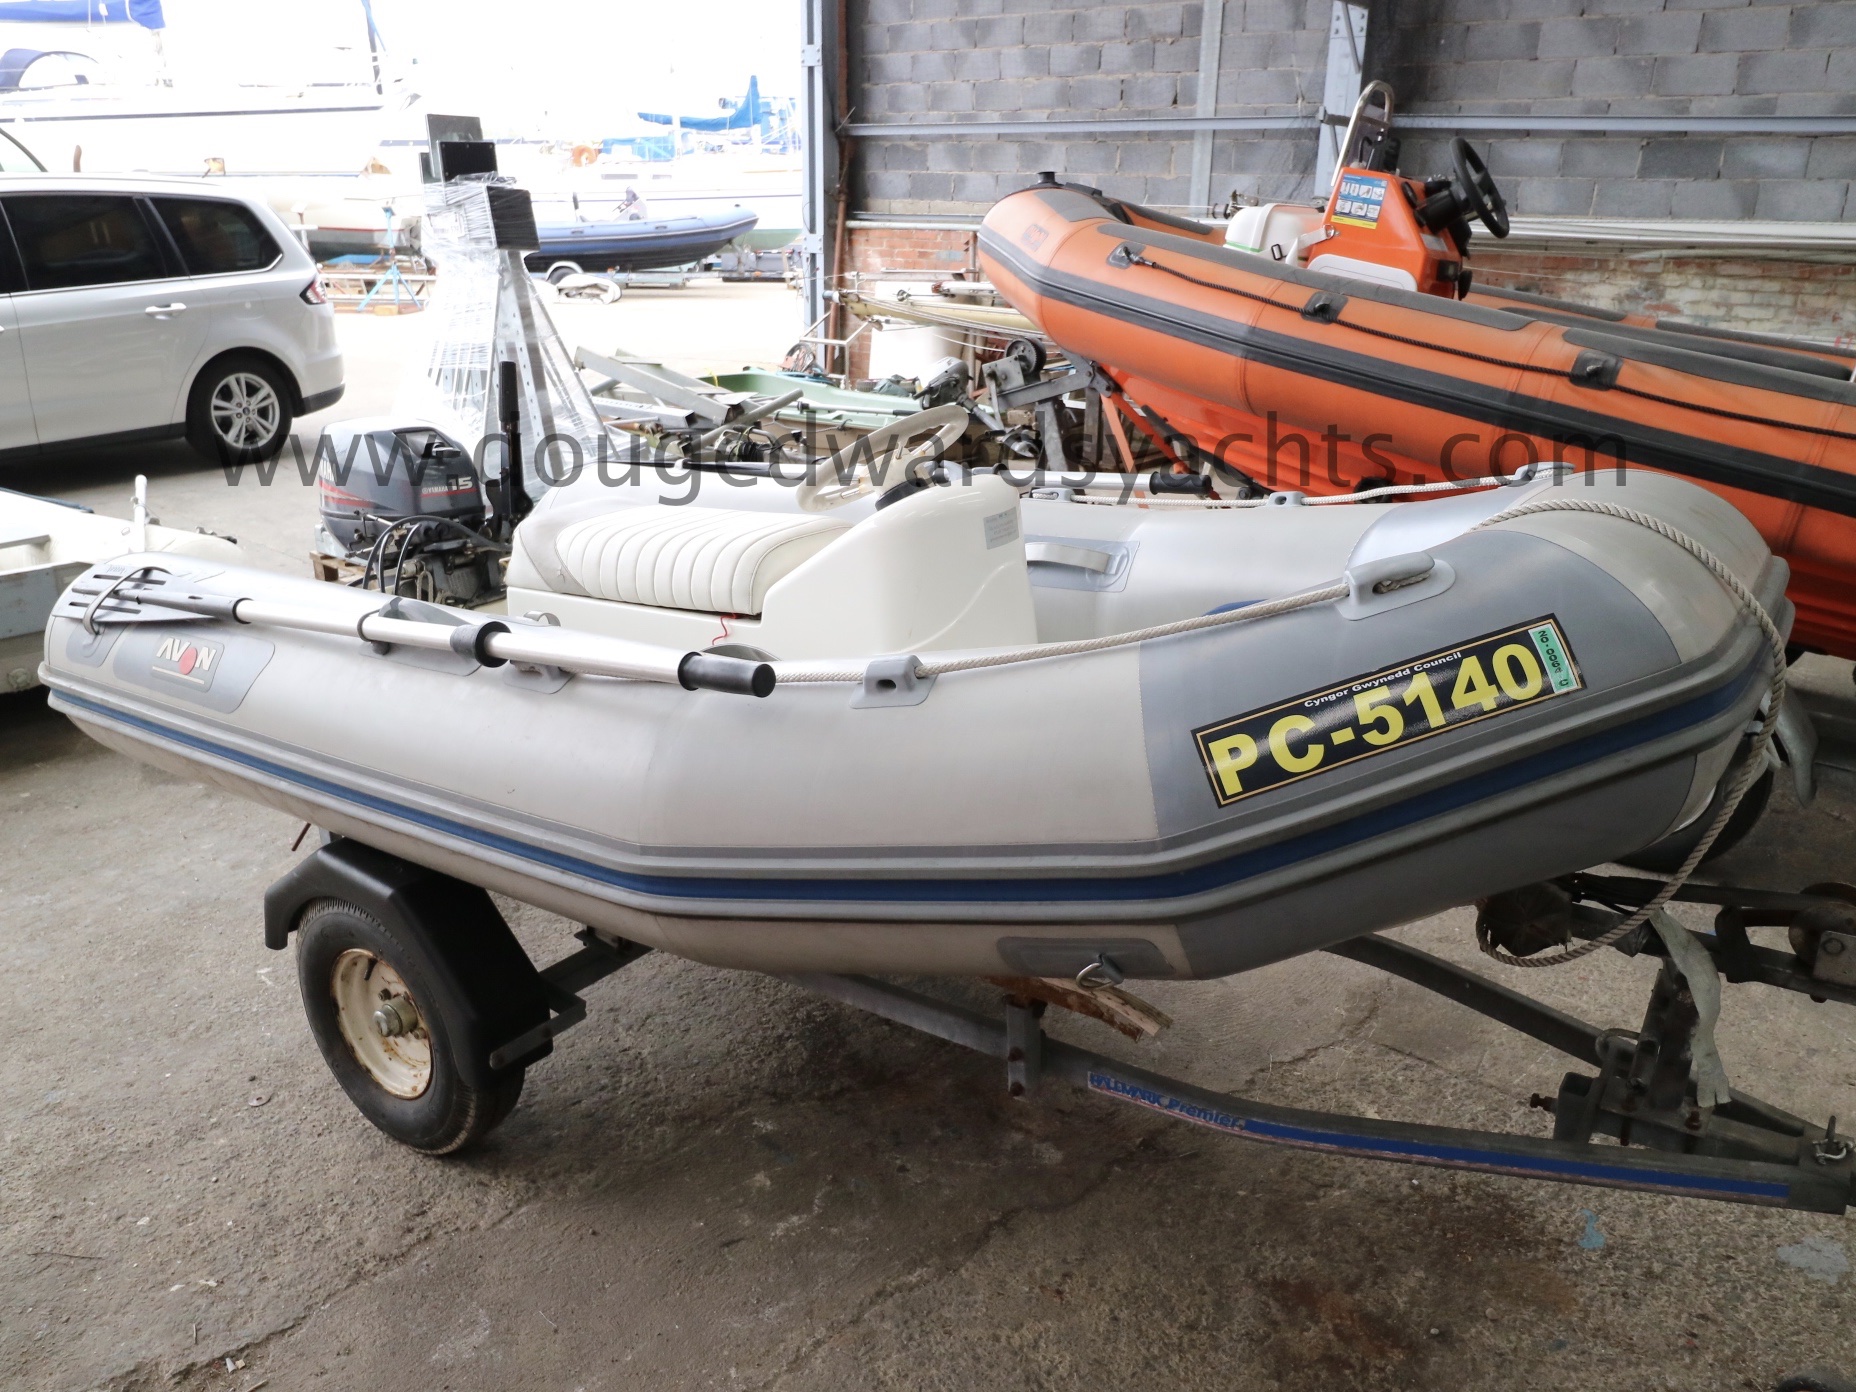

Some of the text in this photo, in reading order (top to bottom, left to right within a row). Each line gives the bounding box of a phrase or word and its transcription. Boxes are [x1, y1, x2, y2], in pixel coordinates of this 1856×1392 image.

[448, 476, 473, 491] 15
[156, 637, 217, 675] AVON
[1304, 652, 1462, 708] Cyngor Gwynedd Council
[1207, 643, 1543, 797] PC-5140
[1090, 1073, 1239, 1127] HALLMARK Premier
